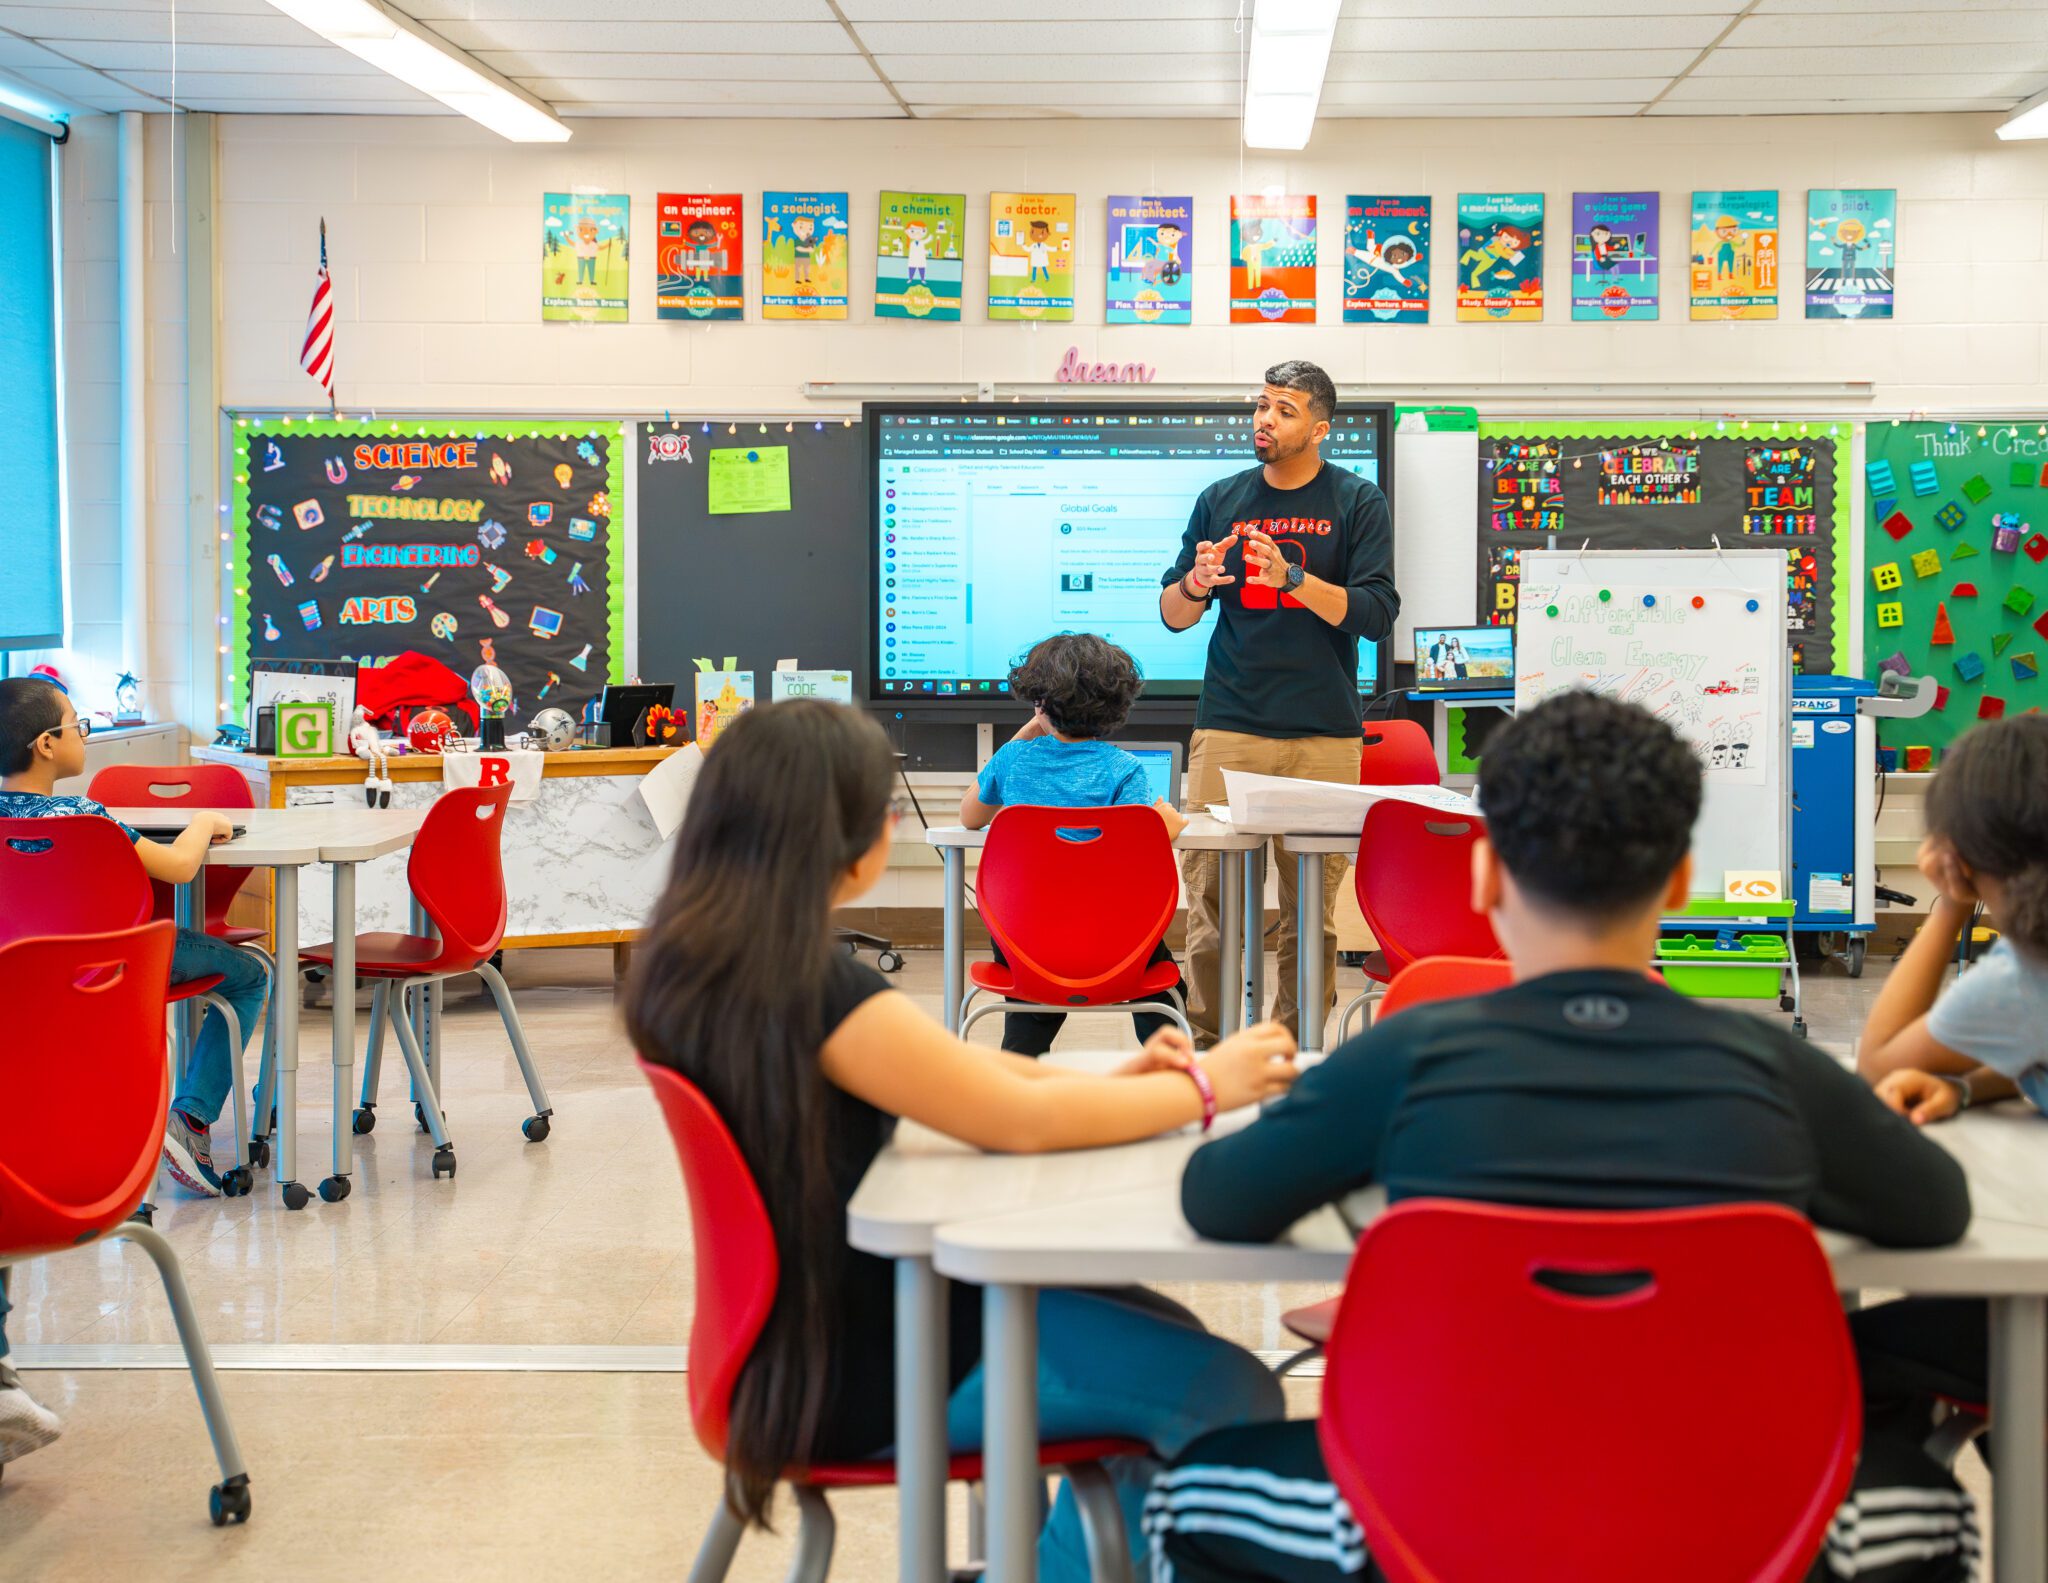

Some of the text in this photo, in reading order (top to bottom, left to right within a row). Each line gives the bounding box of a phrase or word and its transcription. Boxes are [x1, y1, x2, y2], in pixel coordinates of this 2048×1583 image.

[664, 205, 735, 218] an engineer.
[772, 204, 840, 216] a zoologist.
[902, 204, 956, 216] chemist.
[1005, 204, 1060, 216] a doctor.
[1112, 206, 1188, 218] an architect.
[1348, 206, 1429, 217] an astronaut.
[1470, 204, 1499, 213] marine
[1501, 203, 1541, 215] biologist.
[1584, 204, 1591, 212] a
[1621, 204, 1648, 213] game
[1830, 202, 1874, 213] a pilot.
[1593, 213, 1638, 224] designer.
[1056, 346, 1155, 383] dream
[1915, 430, 1971, 456] Think
[354, 443, 478, 469] SCIENCE
[1642, 448, 1658, 457] WE
[1604, 456, 1697, 474] CELEBRATE
[1770, 464, 1792, 474] ARE
[1498, 478, 1561, 493] BETTER
[1611, 474, 1690, 485] EACH OTHER'S
[1747, 487, 1813, 506] TEAM
[347, 494, 484, 522] TECHNOLOGY
[1060, 504, 1118, 513] Global Goals
[341, 543, 480, 568] ENGINEERING
[339, 596, 417, 624] ARTS
[1562, 595, 1688, 624] Affordable
[1608, 624, 1634, 636] and
[1551, 636, 1708, 682] Clean Energy
[787, 683, 817, 696] CODE
[1792, 700, 1835, 710] PRANG
[286, 713, 322, 750] G
[414, 722, 439, 734] RHS
[478, 757, 511, 788] R
